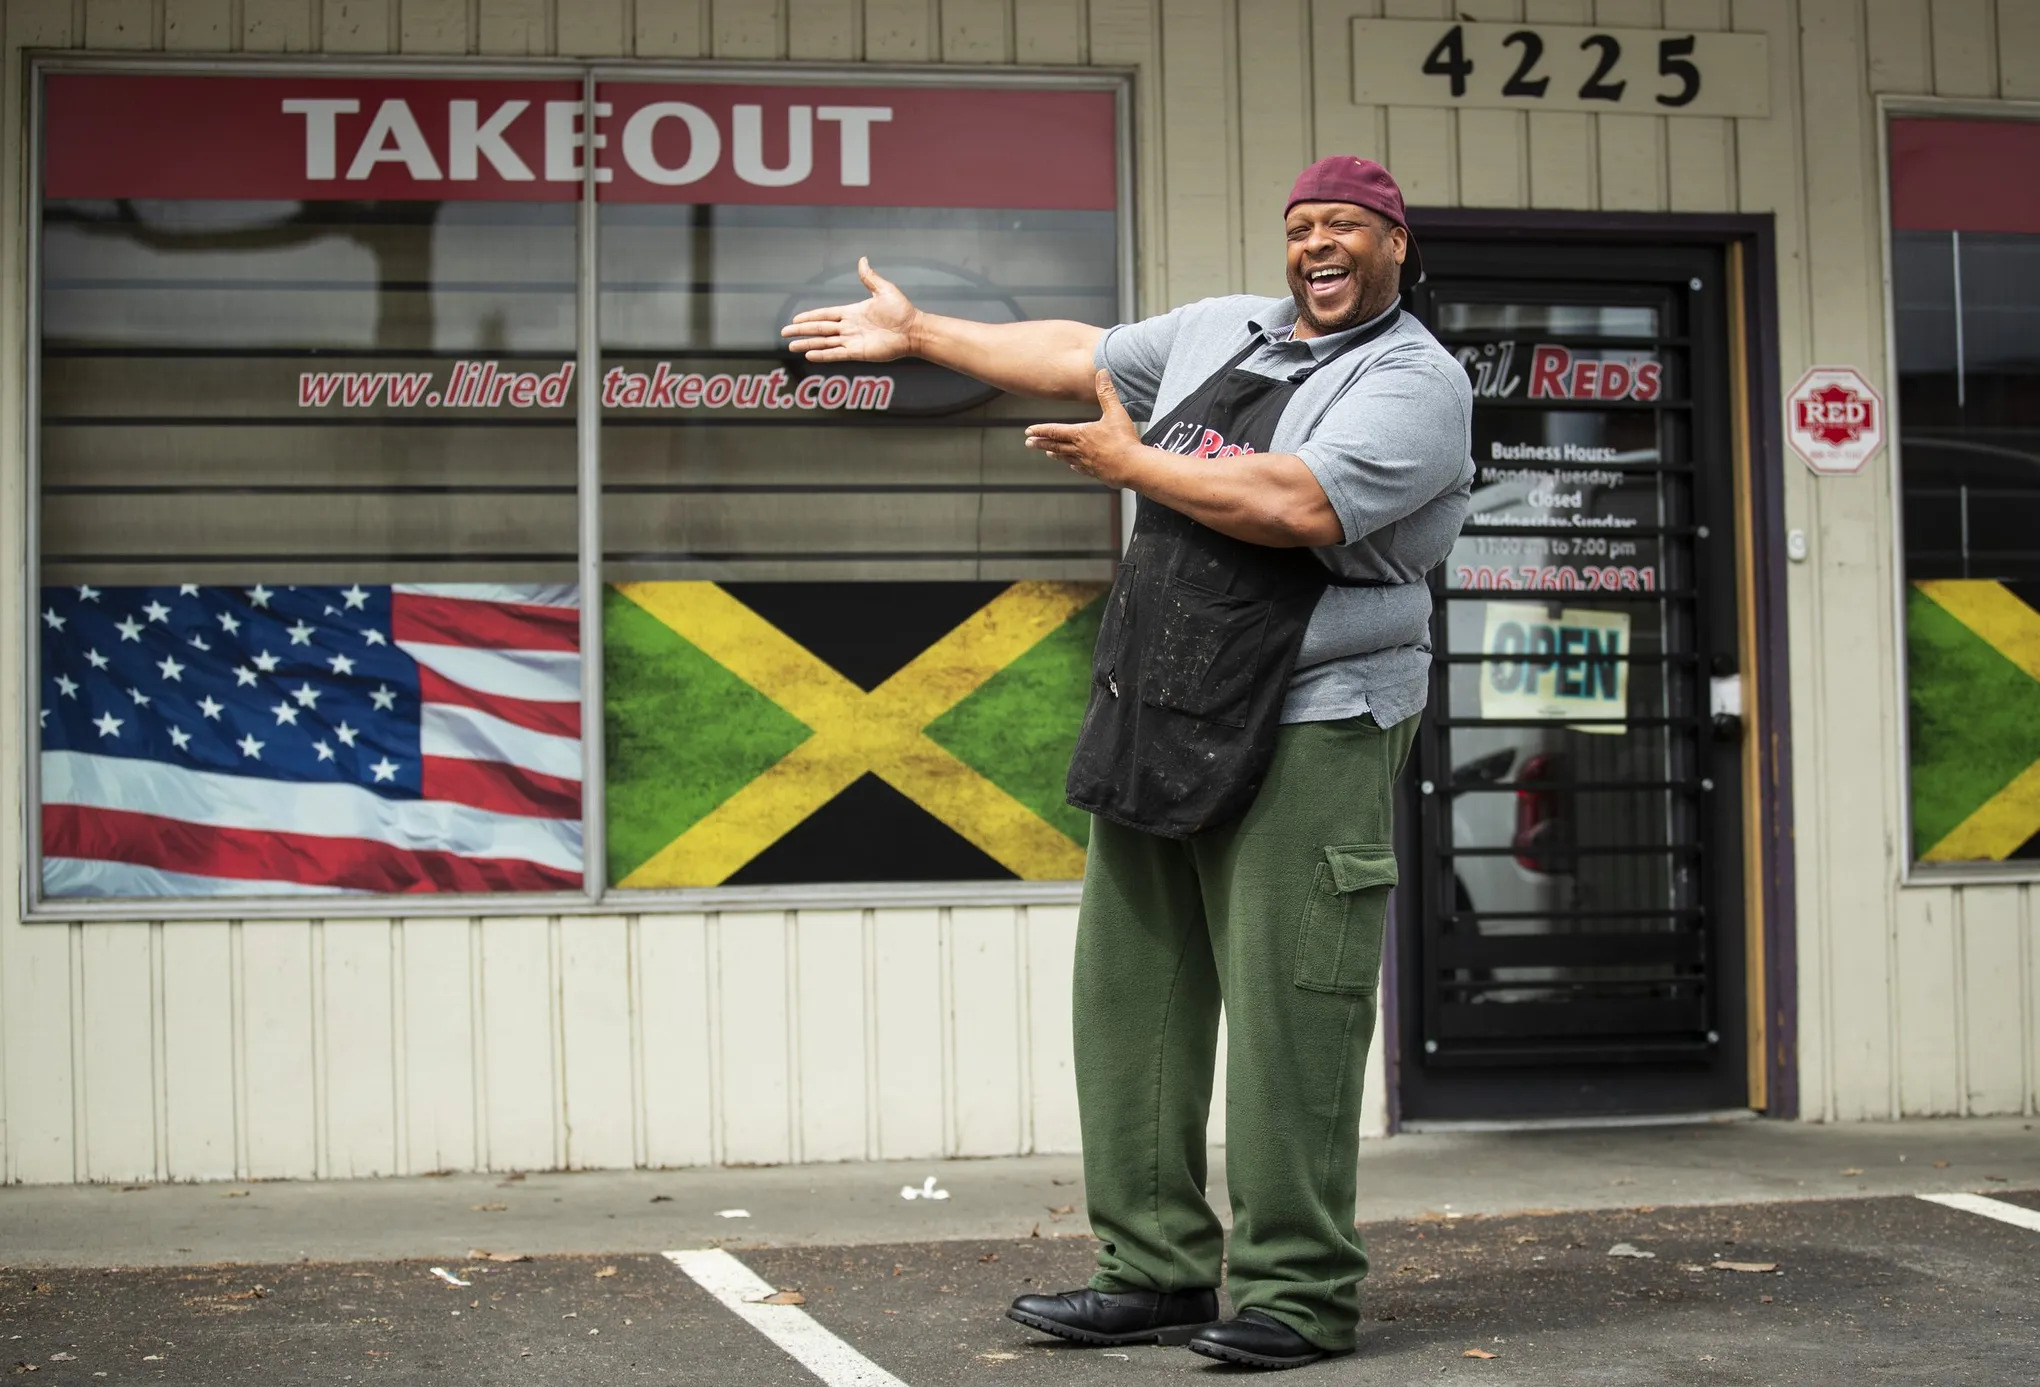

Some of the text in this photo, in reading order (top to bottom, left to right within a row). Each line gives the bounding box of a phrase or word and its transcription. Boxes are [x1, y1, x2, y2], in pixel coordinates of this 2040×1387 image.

[1422, 24, 1700, 107] 4225
[281, 98, 893, 187] TAKEOUT
[601, 363, 895, 410] takeout.com
[1805, 402, 1866, 424] RED
[1491, 442, 1617, 462] Business Hours:
[1528, 490, 1582, 508] Closed
[1552, 540, 1569, 555] to
[1572, 538, 1606, 556] 7:00
[1609, 541, 1636, 559] pm
[1489, 622, 1620, 701] OPEN
